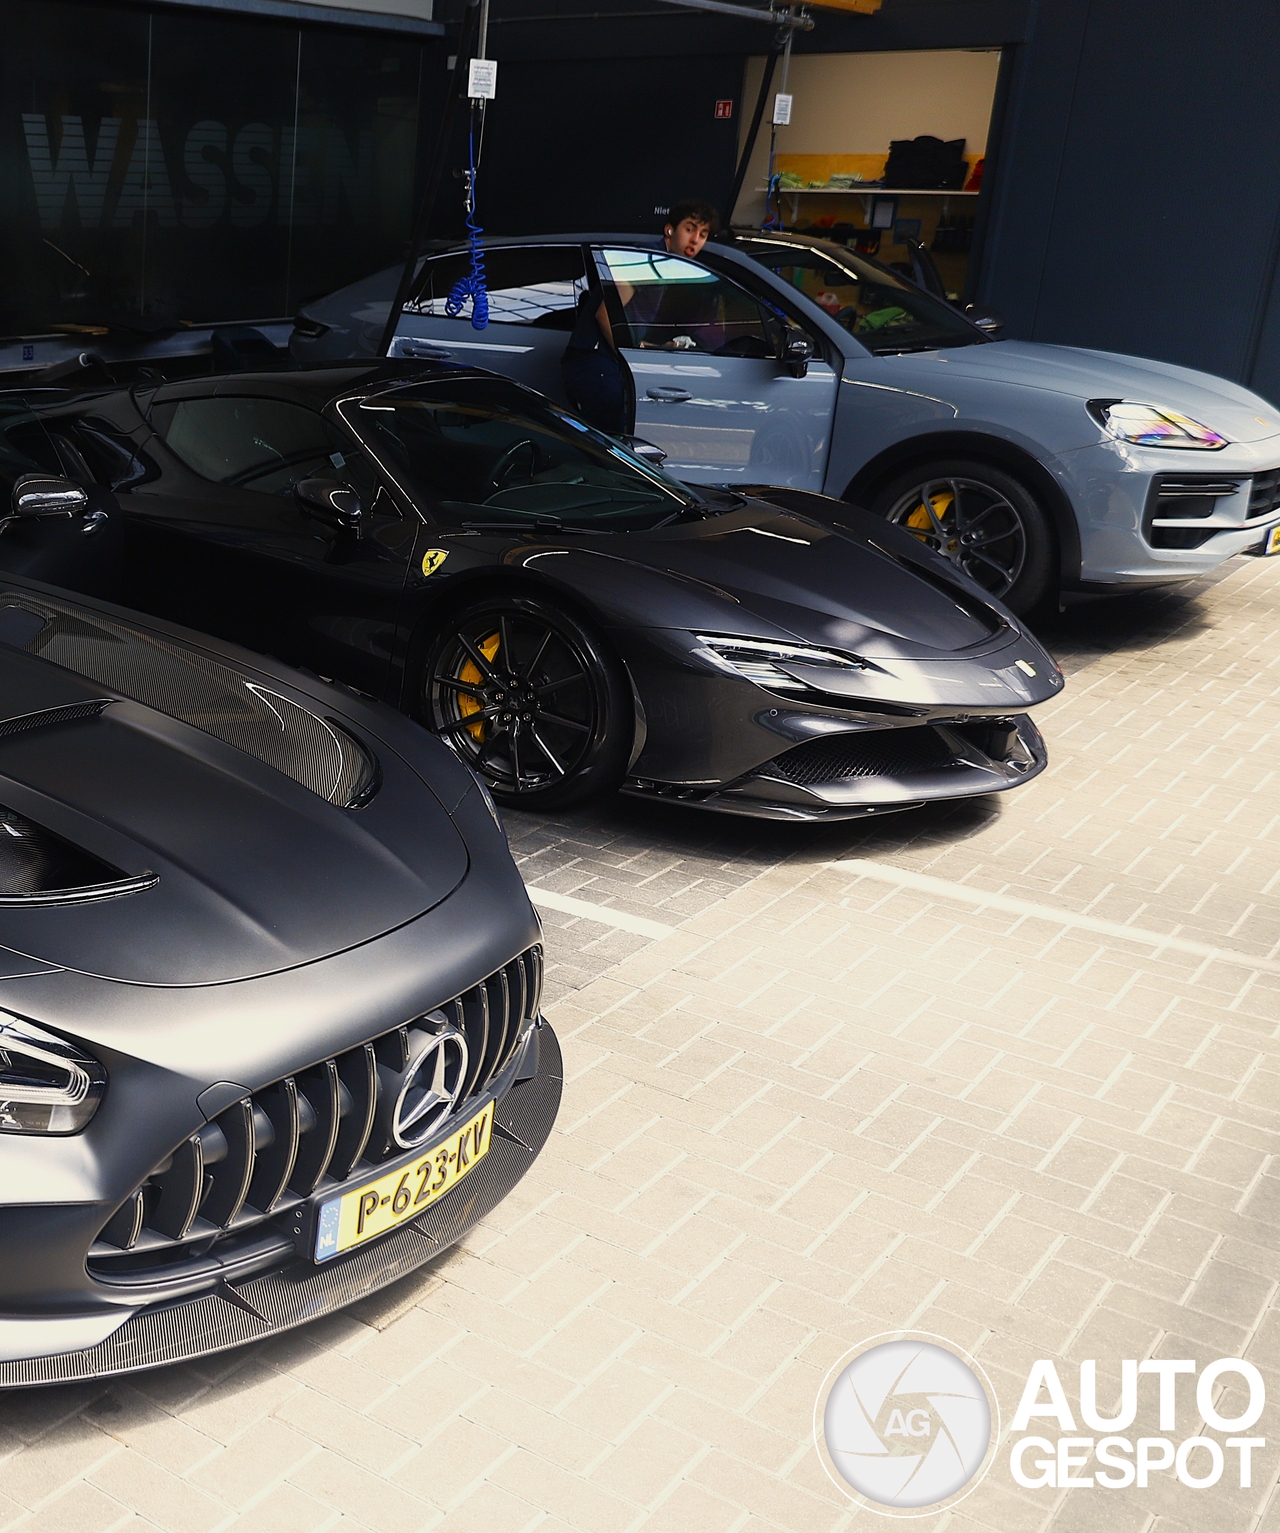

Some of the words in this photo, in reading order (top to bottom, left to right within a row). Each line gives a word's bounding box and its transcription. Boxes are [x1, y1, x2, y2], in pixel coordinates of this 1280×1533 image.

[21, 112, 374, 229] WASSEN
[653, 206, 670, 215] Niet
[357, 1113, 488, 1235] P-623-KV
[319, 1231, 336, 1250] NL
